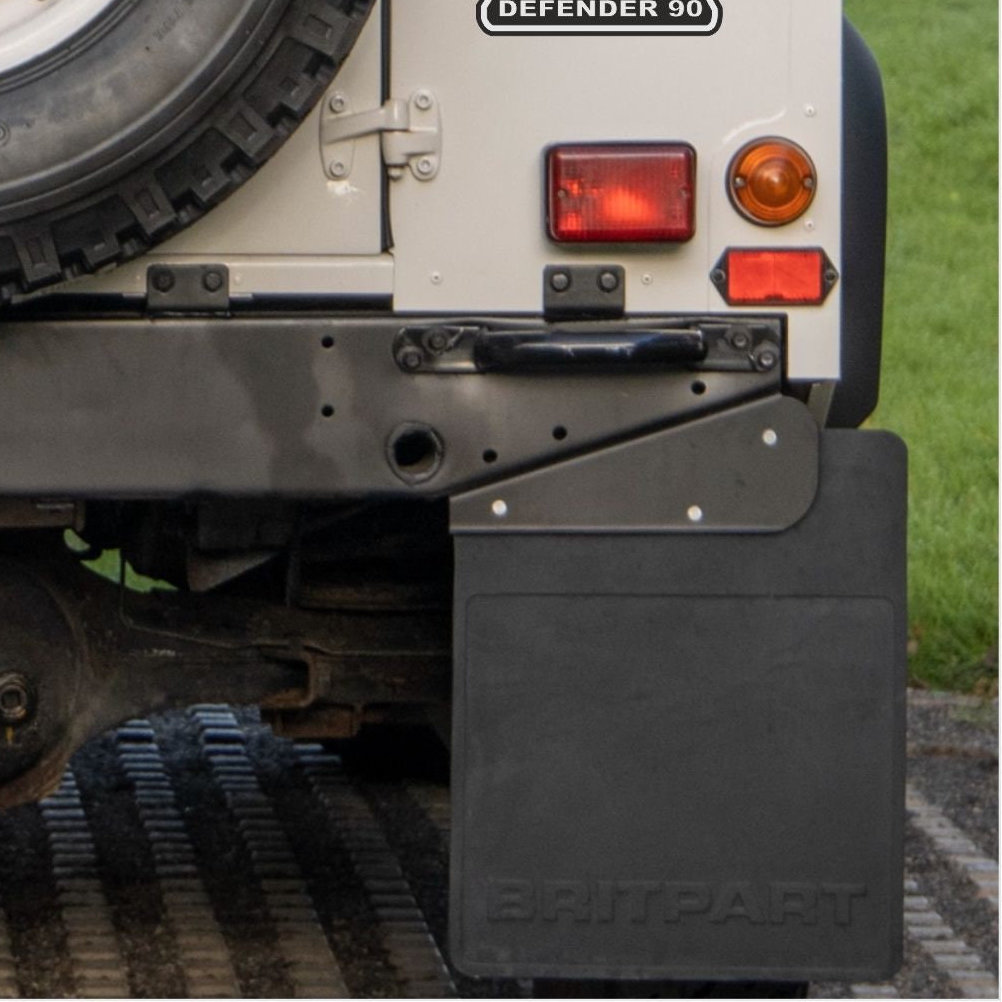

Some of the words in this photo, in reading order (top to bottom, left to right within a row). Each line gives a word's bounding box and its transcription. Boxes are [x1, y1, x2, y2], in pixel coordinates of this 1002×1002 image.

[498, 0, 659, 18] DEFENDER
[668, 0, 704, 18] 90
[487, 877, 868, 926] BRITPART
